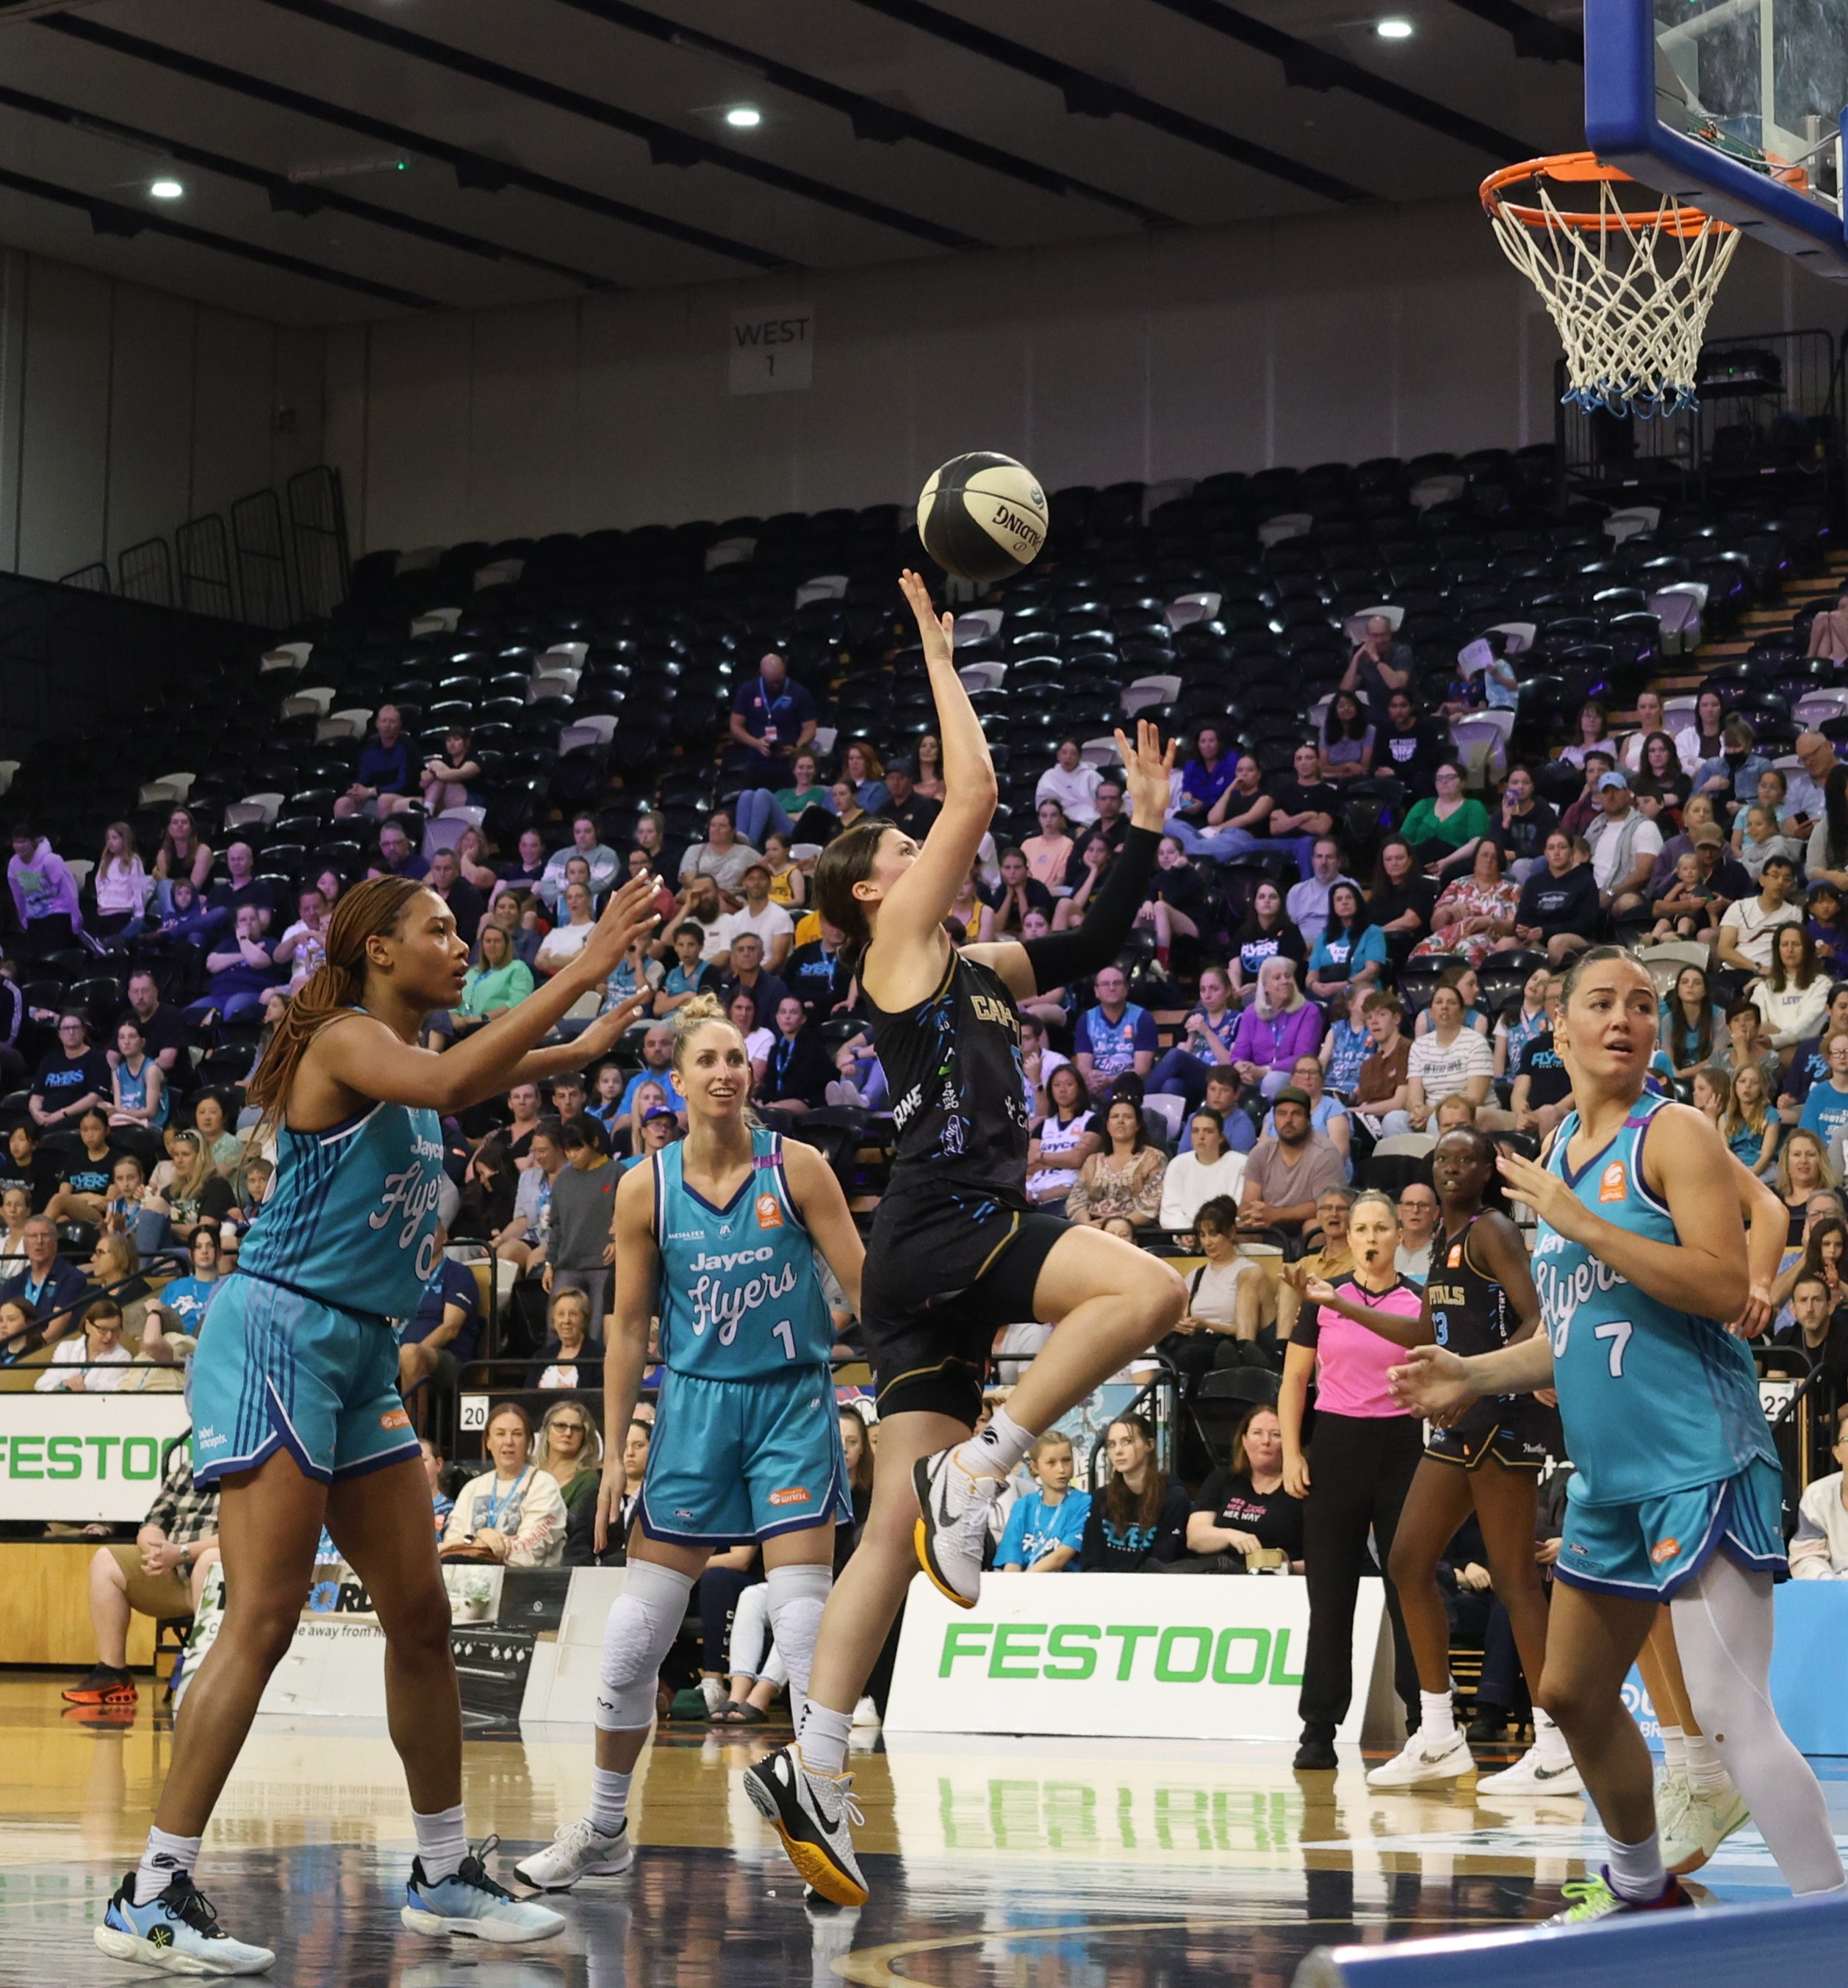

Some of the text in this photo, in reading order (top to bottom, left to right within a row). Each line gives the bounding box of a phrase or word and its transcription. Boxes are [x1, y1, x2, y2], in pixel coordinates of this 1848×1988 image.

[735, 316, 810, 347] WEST
[766, 354, 774, 376] 1
[689, 1247, 774, 1272] Jayco
[688, 1262, 797, 1346] Flyers
[772, 1320, 797, 1360] 1
[1594, 1321, 1633, 1378] 7
[464, 1408, 484, 1425] 20
[1764, 1396, 1791, 1415] 22
[0, 1436, 193, 1480] ESTO
[1223, 1510, 1261, 1522] HER WAY
[308, 1627, 338, 1639] away
[341, 1625, 369, 1638] from
[938, 1623, 1304, 1685] FESTOOL
